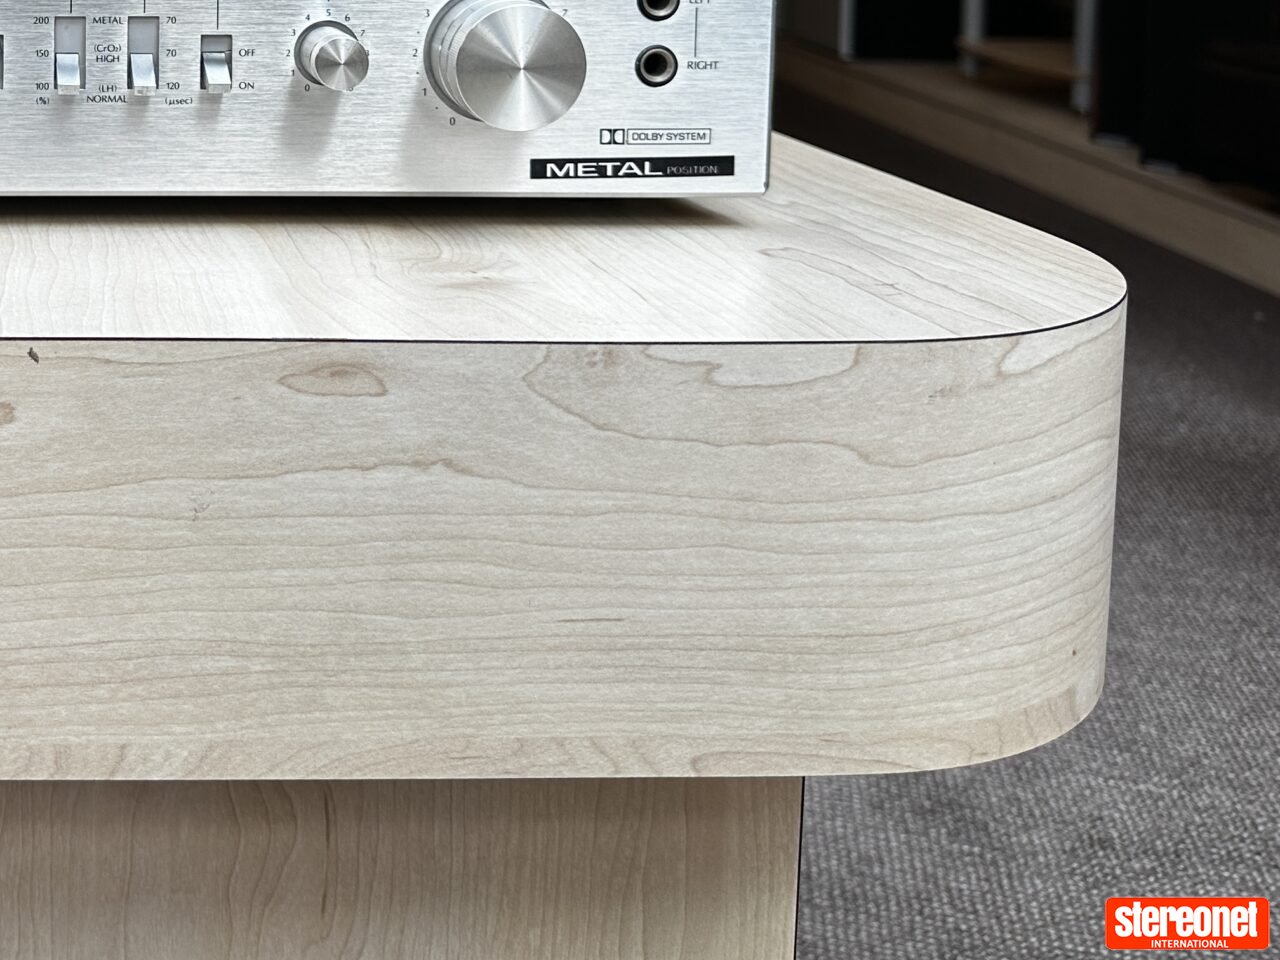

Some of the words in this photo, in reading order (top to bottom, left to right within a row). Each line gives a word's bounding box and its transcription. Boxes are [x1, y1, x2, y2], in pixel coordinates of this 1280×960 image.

[424, 8, 430, 18] 3
[32, 16, 50, 25] 200
[92, 16, 124, 25] METAL
[166, 16, 177, 25] 70
[36, 48, 50, 58] 150
[166, 48, 177, 58] 70
[238, 48, 256, 57] OFF
[412, 48, 418, 58] 2
[95, 54, 120, 64] HIGH
[686, 60, 720, 70] RIGHT
[36, 82, 50, 91] 100
[98, 84, 118, 94] (LH)
[166, 82, 180, 90] 120
[238, 81, 254, 90] ON
[86, 94, 128, 104] NORMAL
[449, 117, 456, 126] 0
[632, 132, 664, 141] DOLBY
[666, 132, 706, 140] SYSTEM
[546, 161, 664, 178] METAL
[666, 164, 718, 175] POSITION
